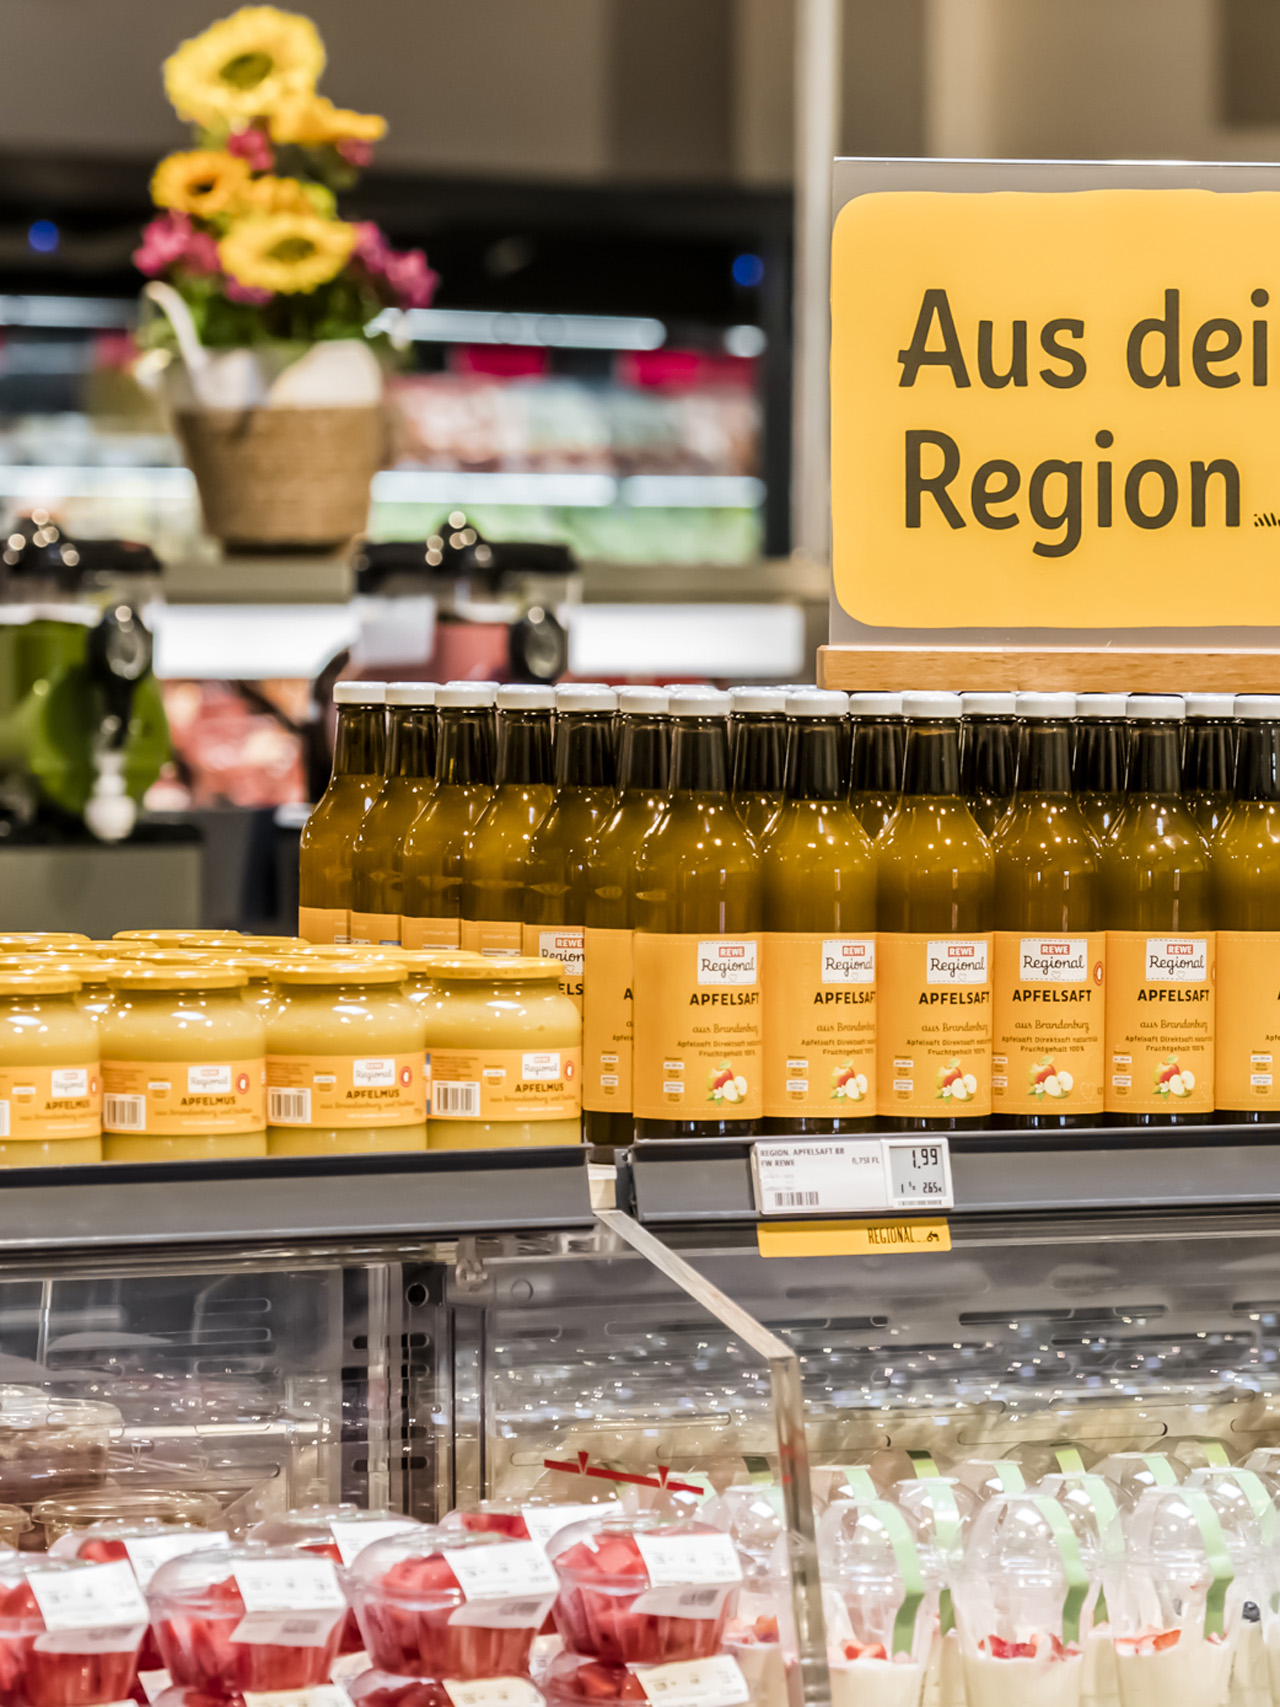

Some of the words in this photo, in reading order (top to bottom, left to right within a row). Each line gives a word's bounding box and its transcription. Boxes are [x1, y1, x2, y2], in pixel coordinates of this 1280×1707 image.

[897, 288, 1087, 388] Aus
[904, 429, 1239, 558] Region
[556, 939, 583, 947] REWE
[542, 949, 585, 962] Region
[719, 947, 744, 957] REWE
[843, 946, 865, 956] REWE
[949, 947, 974, 956] REWE
[1041, 945, 1069, 954] REWE
[1167, 945, 1193, 954] REWE
[701, 958, 754, 978] Regional
[825, 957, 873, 977] Regional
[931, 957, 985, 977] Regional
[1024, 955, 1085, 975] Regional
[1150, 955, 1204, 975] Regional
[690, 993, 759, 1005] APFELSAFT
[814, 992, 876, 1004] APFELSAF
[919, 992, 989, 1004] APFELSAFT
[1013, 990, 1092, 1002] APFELSAFT
[1138, 989, 1209, 1002] APFELSAFT
[693, 1025, 711, 1033] aus
[817, 1024, 835, 1032] aus
[922, 1024, 940, 1032] aus
[1015, 1021, 1032, 1029] aus
[515, 1083, 564, 1092] APFELMUS
[346, 1089, 400, 1099] APFELMUS
[181, 1097, 236, 1106] APFELMUS
[912, 1148, 938, 1169] 1.99
[867, 1227, 914, 1244] REGIONAL
